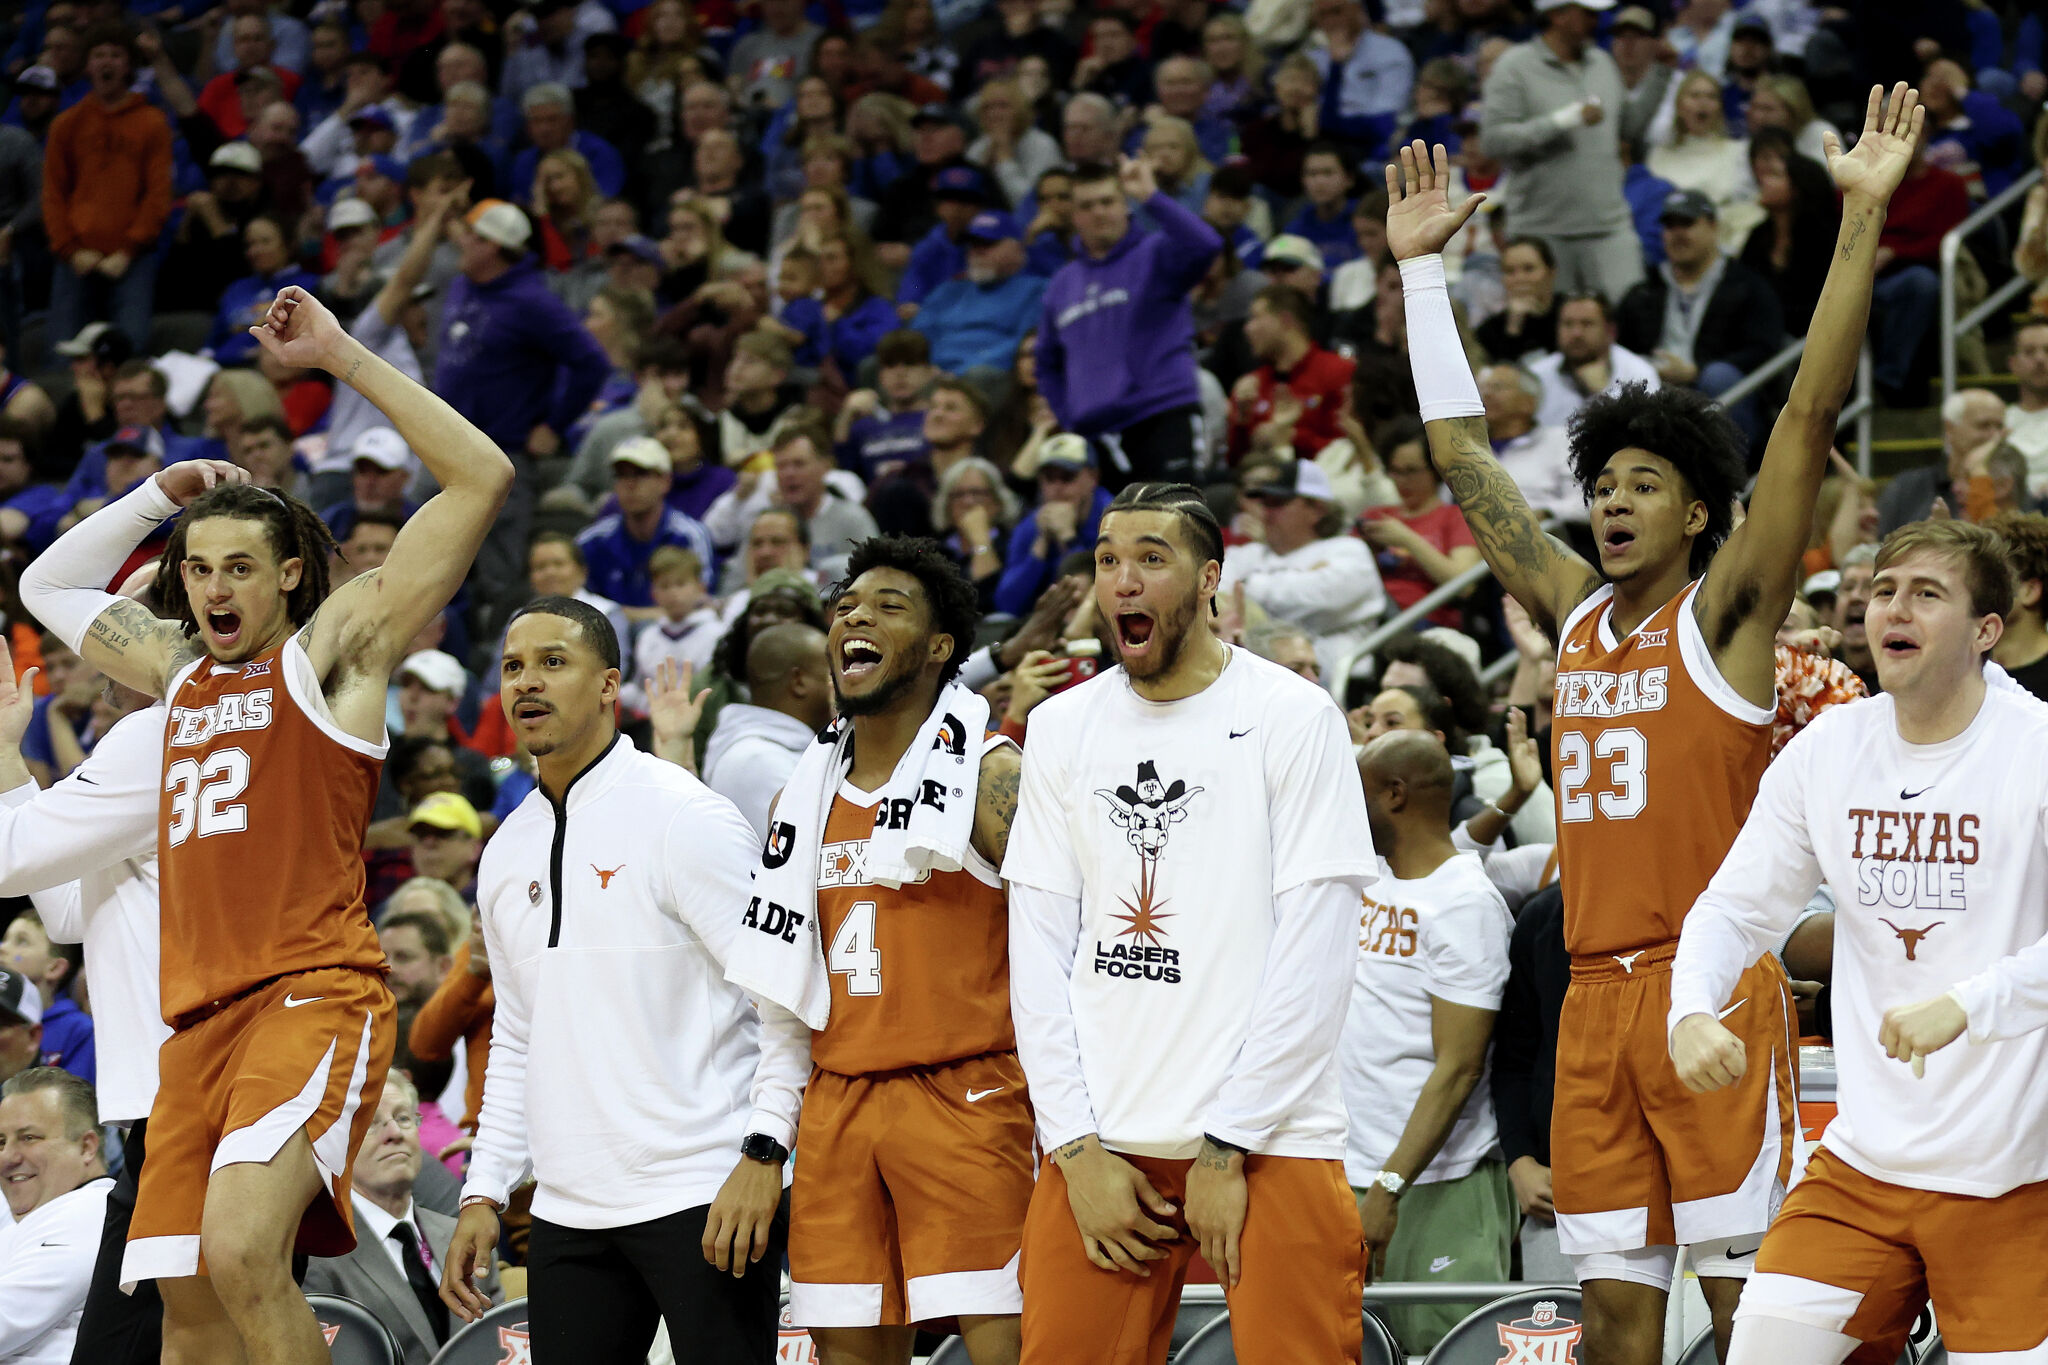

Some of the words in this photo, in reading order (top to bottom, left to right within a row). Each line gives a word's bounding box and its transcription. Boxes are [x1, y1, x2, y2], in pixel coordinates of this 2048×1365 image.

[1555, 666, 1668, 718] TEXAS
[165, 747, 251, 849] 32
[1559, 727, 1648, 823] 23
[1849, 808, 1980, 865] TEXAS
[1858, 854, 1967, 911] SOLE
[828, 901, 882, 996] 4
[1094, 958, 1182, 984] FOCUS
[1096, 940, 1180, 966] LASER
[1536, 1311, 1552, 1321] 66
